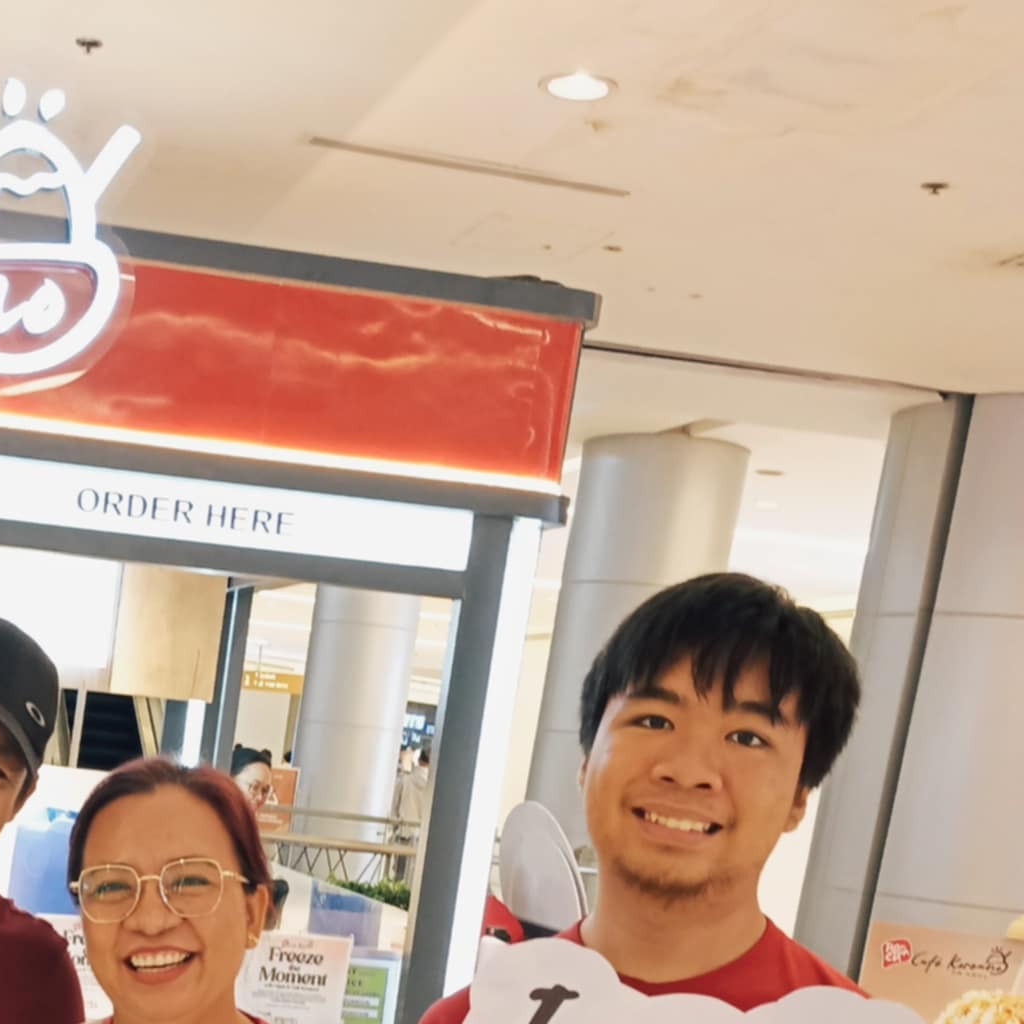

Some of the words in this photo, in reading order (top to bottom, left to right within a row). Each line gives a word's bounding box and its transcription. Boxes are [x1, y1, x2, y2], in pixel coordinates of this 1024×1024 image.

[77, 487, 194, 526] ORDER
[206, 506, 296, 537] HERE
[269, 946, 324, 966] Freeze
[259, 965, 328, 987] Moment
